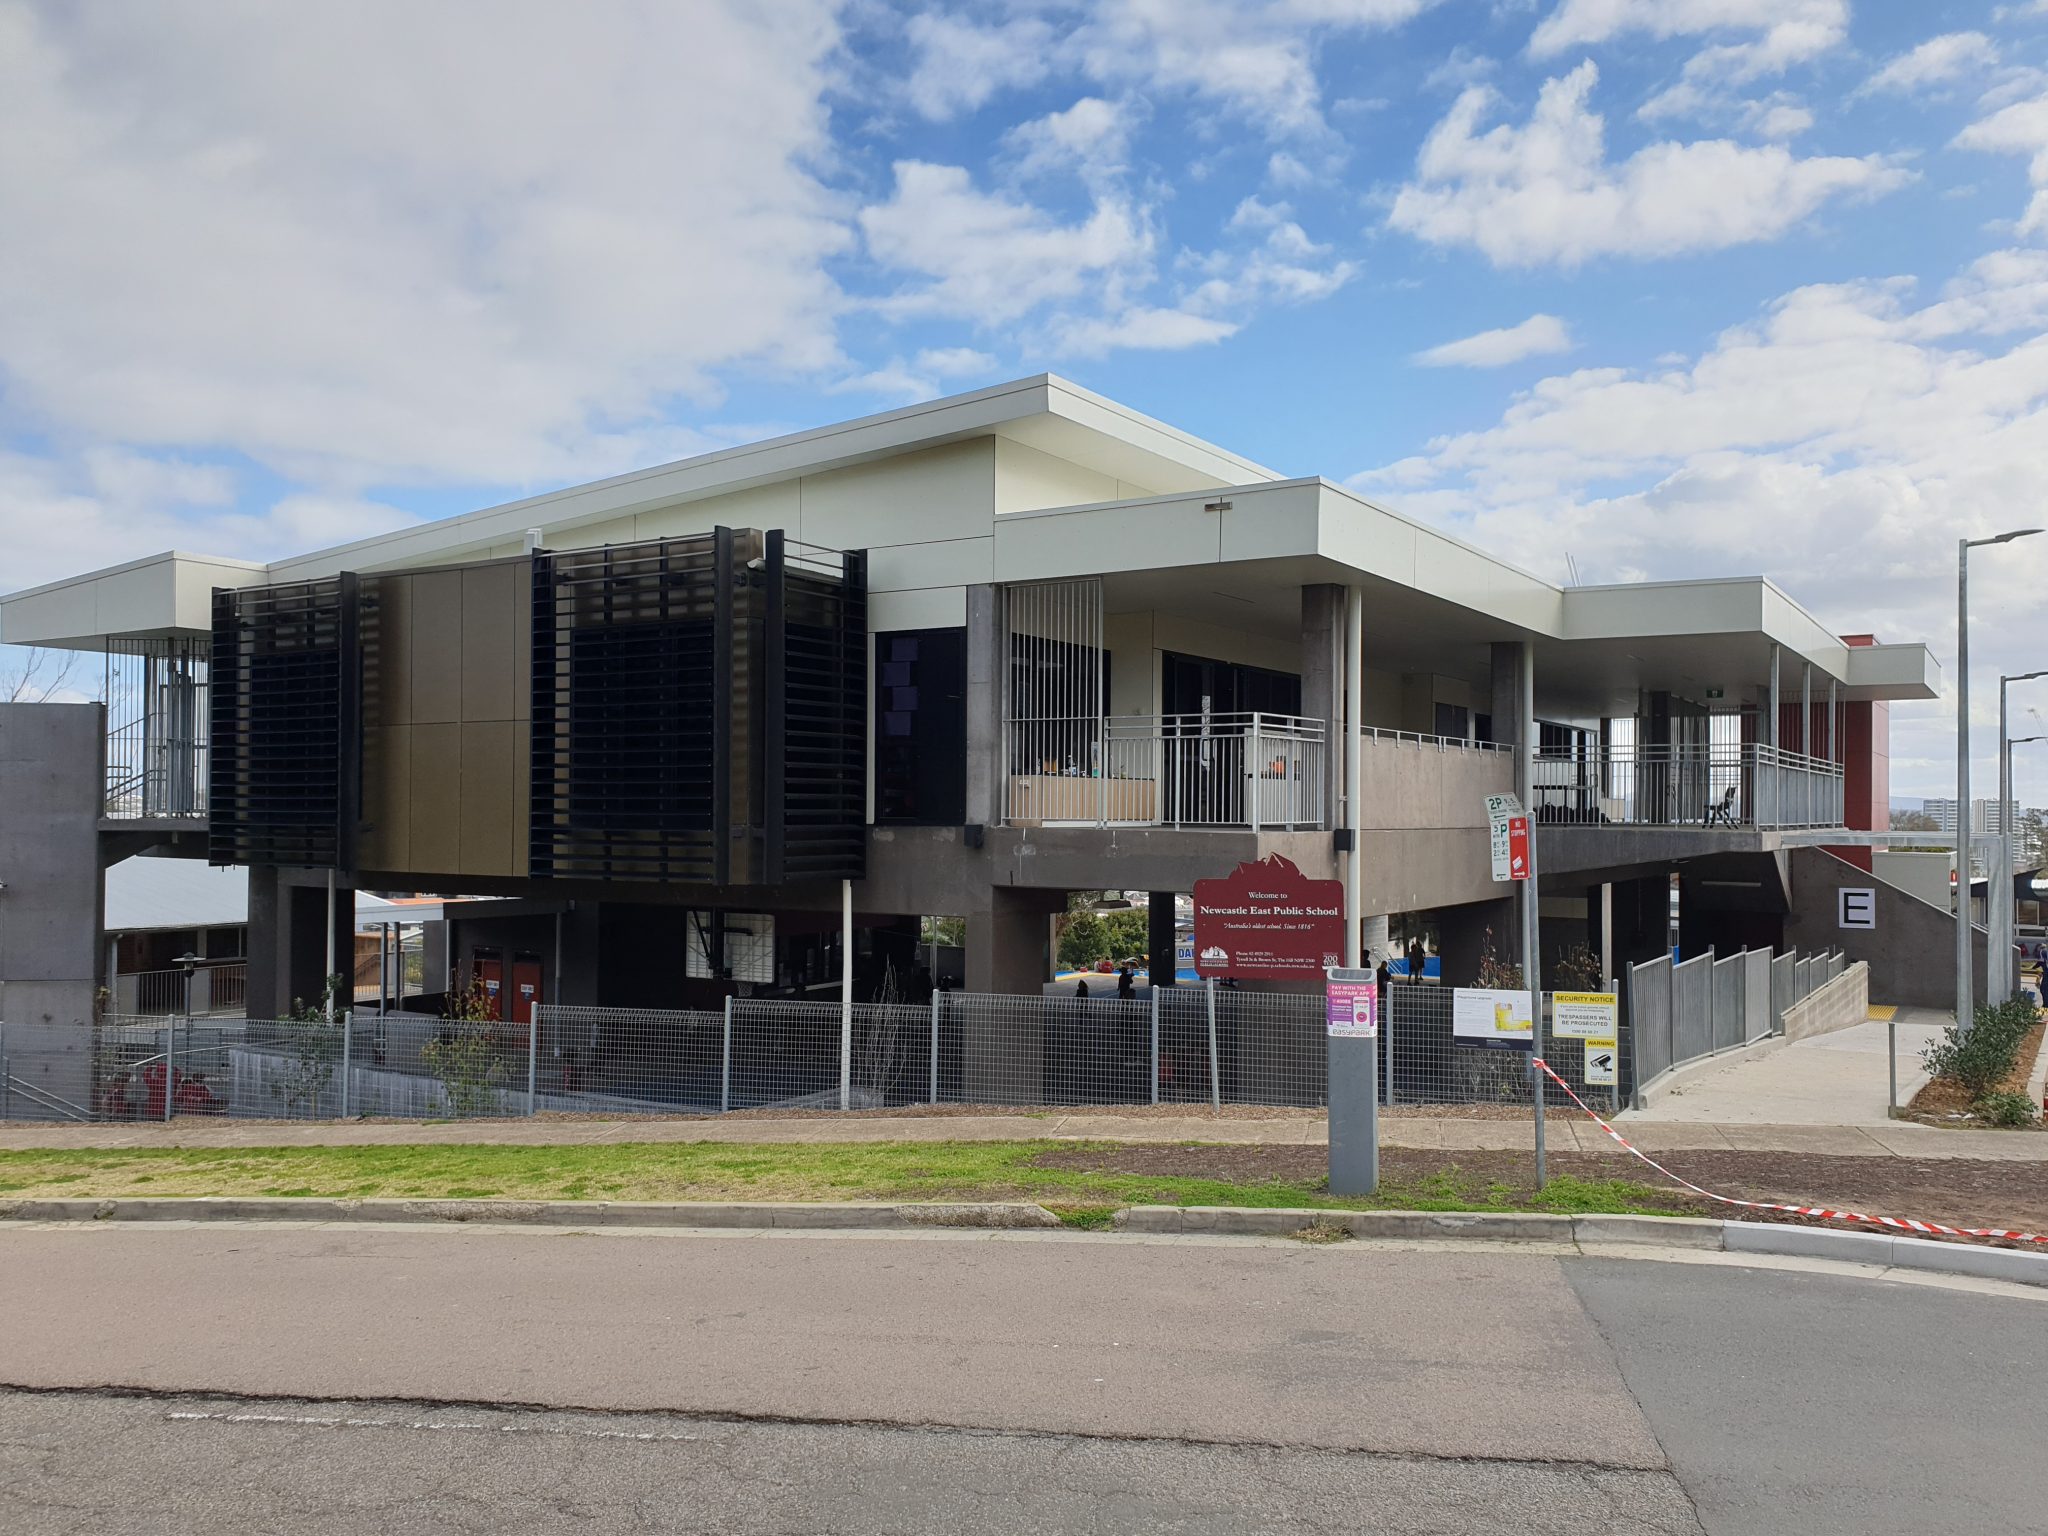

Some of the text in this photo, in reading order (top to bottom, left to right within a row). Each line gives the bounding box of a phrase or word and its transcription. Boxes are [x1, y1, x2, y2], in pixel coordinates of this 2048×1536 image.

[1489, 798, 1502, 810] 2P
[1501, 824, 1507, 838] P
[1200, 906, 1338, 916] Newcastle East Public School
[1844, 893, 1870, 924] E
